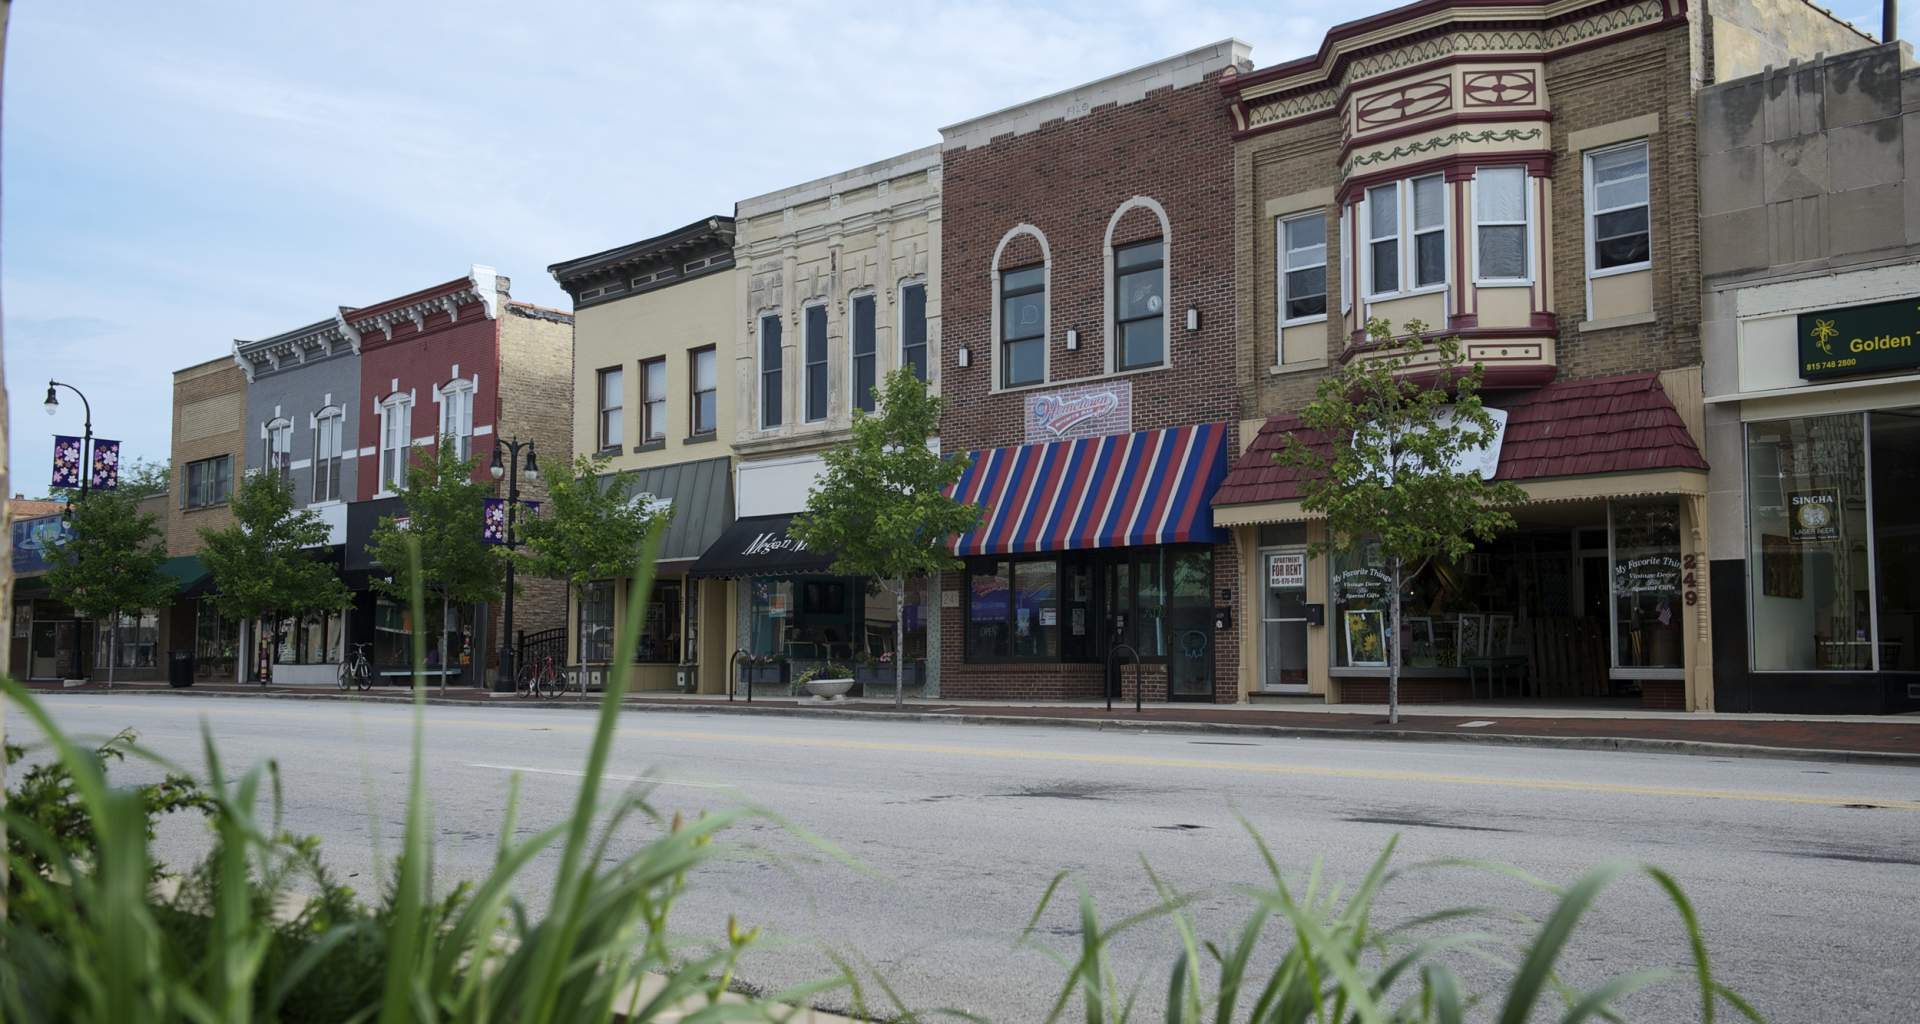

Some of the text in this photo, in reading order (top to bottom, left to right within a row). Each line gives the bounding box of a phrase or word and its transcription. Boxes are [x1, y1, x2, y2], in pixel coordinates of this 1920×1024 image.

[1850, 336, 1911, 352] Golden
[1792, 495, 1833, 505] SINGHA
[741, 532, 791, 555] Megan
[1272, 564, 1301, 576] FOR RENT
[1628, 557, 1660, 569] Favorite
[1684, 554, 1697, 606] 249
